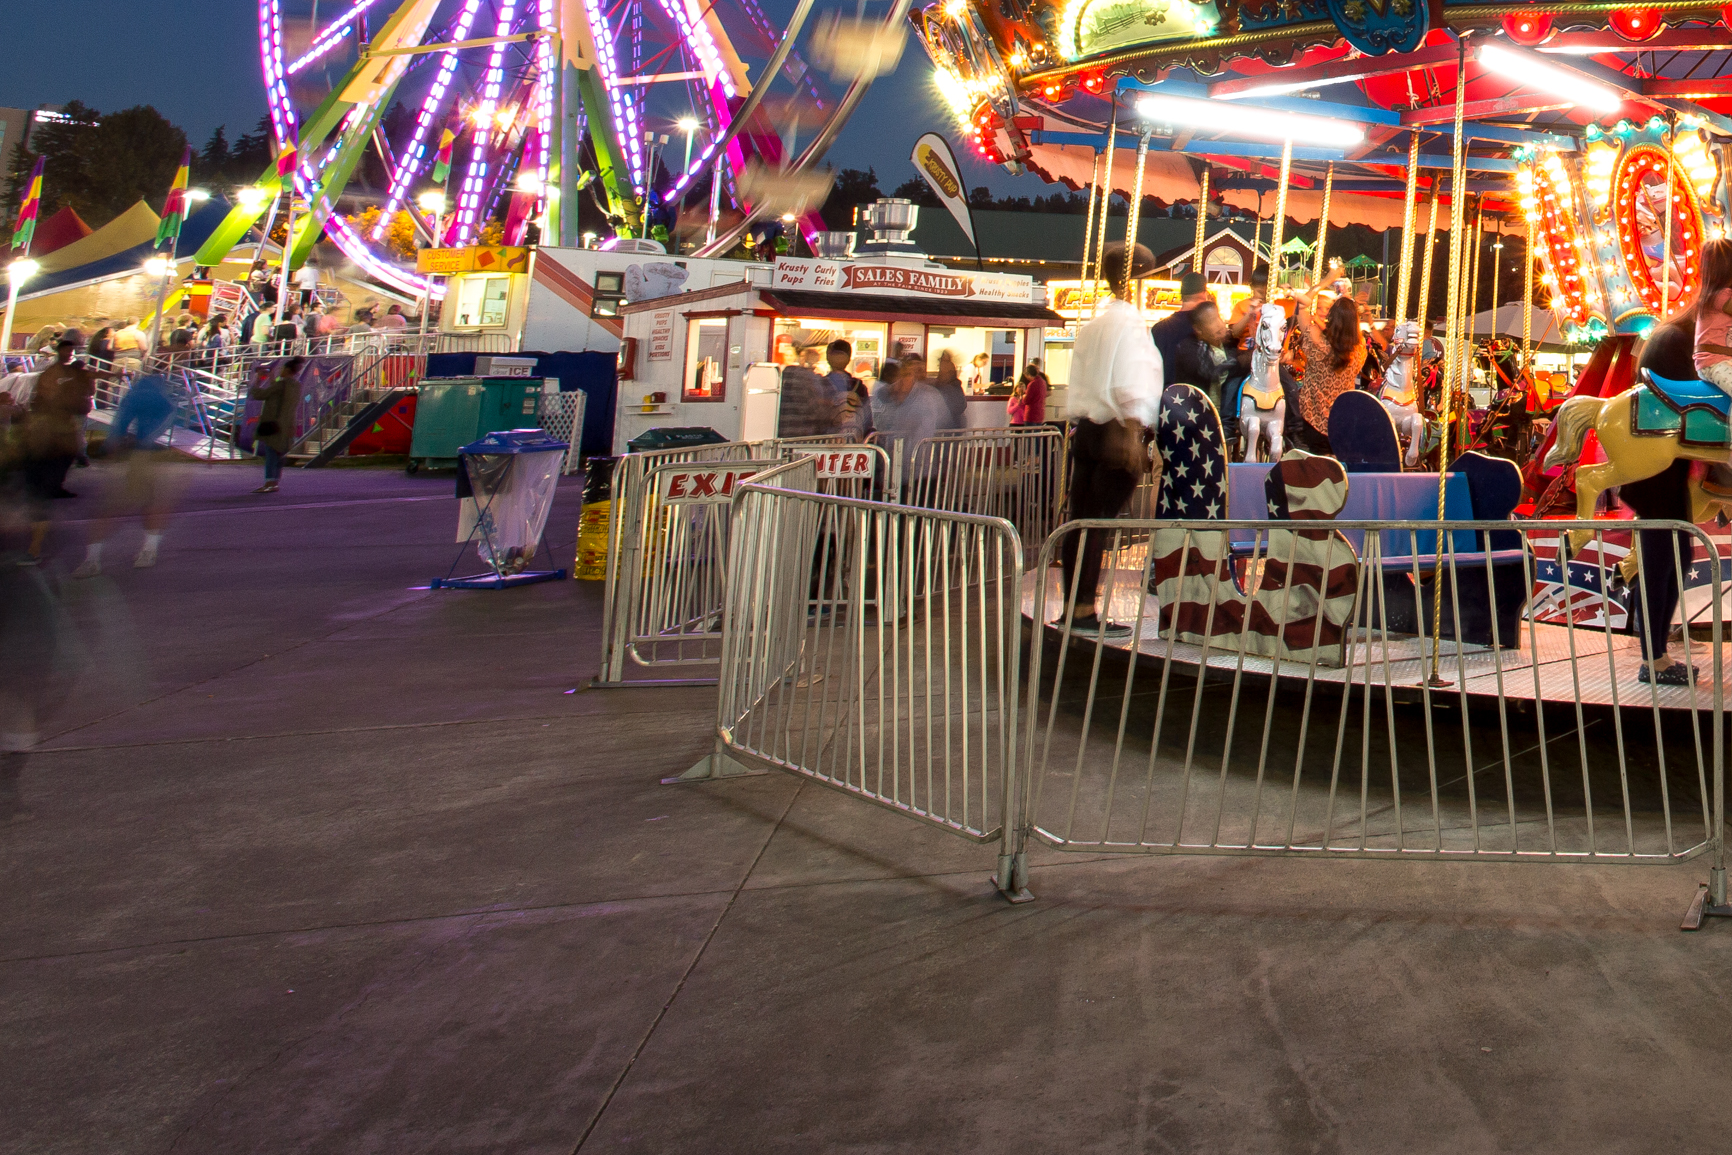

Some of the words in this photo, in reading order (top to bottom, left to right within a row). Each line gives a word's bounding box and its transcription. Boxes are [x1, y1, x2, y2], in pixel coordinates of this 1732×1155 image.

[945, 179, 957, 193] PUP
[426, 249, 466, 260] CUSTOMER
[430, 261, 460, 271] SERVICE
[778, 262, 809, 275] Krusty
[814, 264, 836, 277] Curly
[780, 273, 804, 285] Pups
[814, 276, 835, 286] Fries
[856, 268, 904, 283] SALES
[909, 272, 965, 290] FAMILY
[979, 288, 1005, 298] Healthy
[509, 367, 529, 376] ICE
[816, 453, 869, 474] NTER
